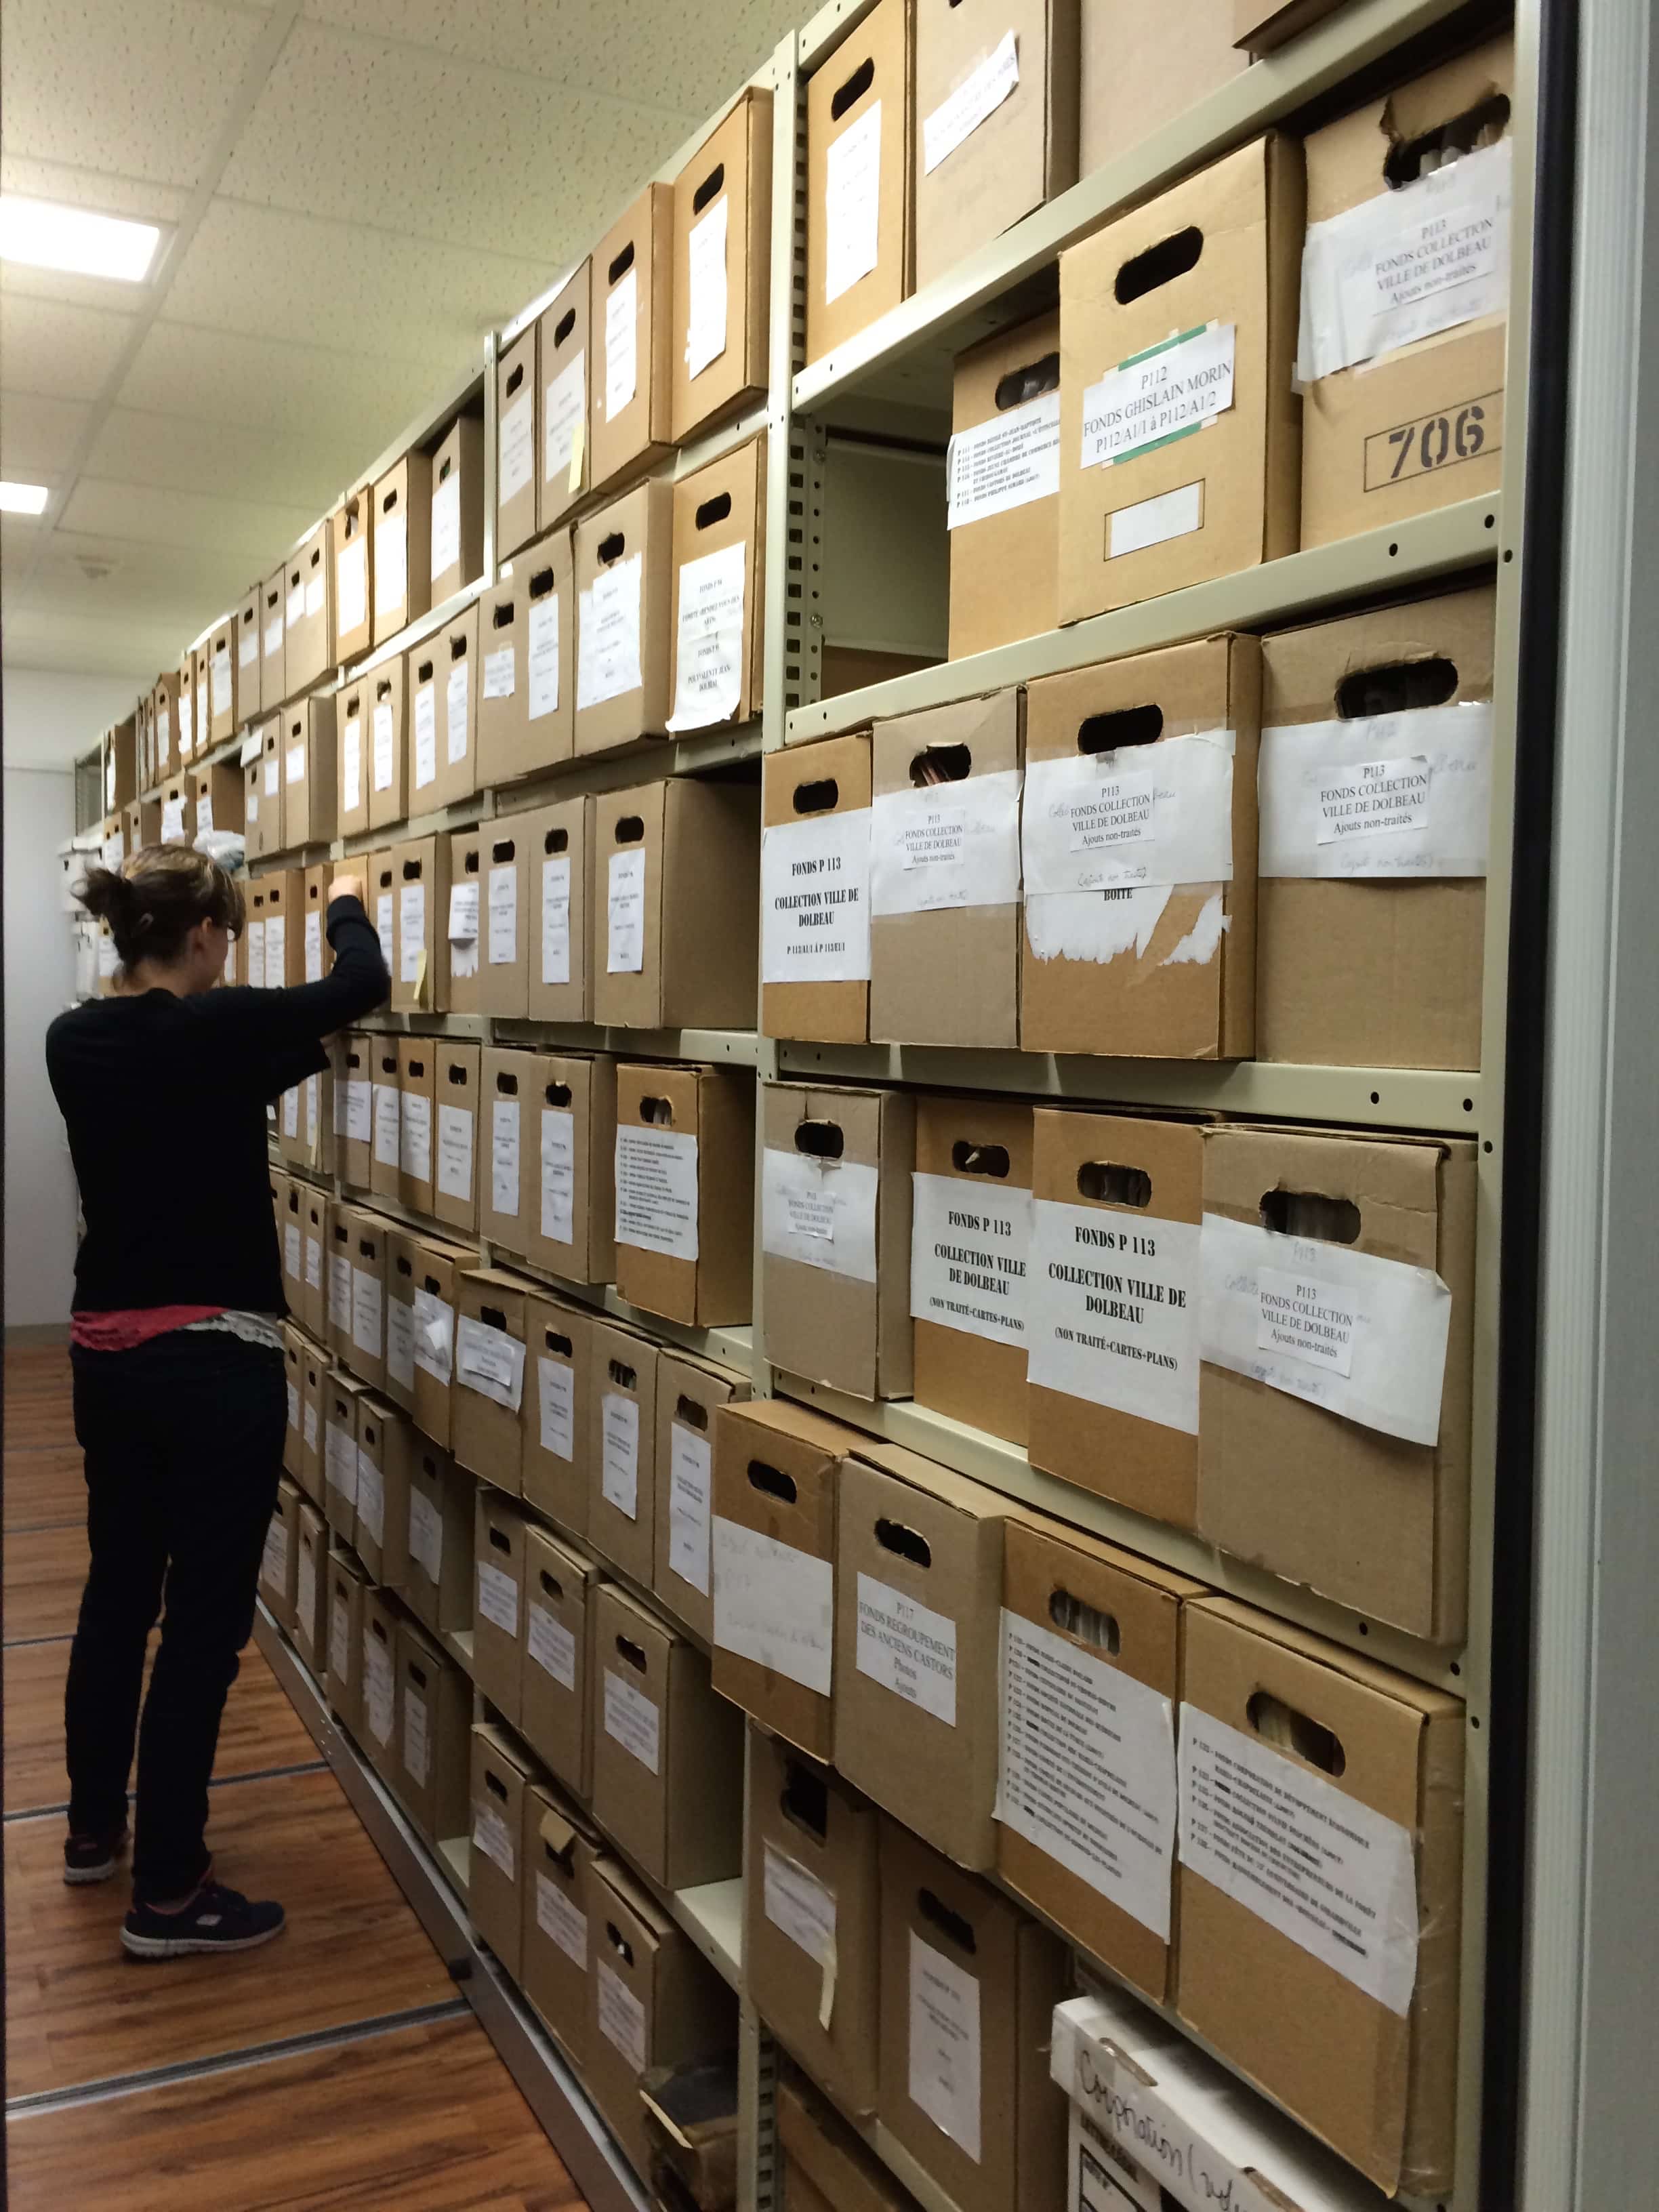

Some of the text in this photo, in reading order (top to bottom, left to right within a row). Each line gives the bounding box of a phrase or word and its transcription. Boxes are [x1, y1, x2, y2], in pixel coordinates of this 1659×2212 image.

[1141, 366, 1168, 390] P112
[1084, 361, 1231, 437] FONDS GHISLAIN MORIN
[1389, 405, 1485, 478] 706
[1363, 764, 1385, 779] P113
[1101, 785, 1120, 798] P113
[1321, 775, 1427, 802] FONDS COLLECTION
[1070, 804, 1097, 819] FONDS
[1099, 794, 1151, 814] COLLECTION
[1323, 792, 1425, 818] VILLE DE DOLBEAU
[927, 814, 941, 825] P113
[1072, 809, 1150, 832] VILLE DE DOLBEAU
[1334, 813, 1412, 835] Ajouts non-traités
[905, 829, 925, 840] FONDS
[926, 825, 963, 838] COLLECTION
[906, 838, 960, 852] VILLE DE DOLBEAU
[1082, 827, 1141, 847] Ajouts non-traités
[792, 857, 841, 876] FONDS P 113
[775, 888, 859, 910] COLLECTION VILLE DE
[798, 911, 835, 927] DOLBEAU
[949, 1211, 1012, 1237] FONDS P 113
[1075, 1226, 1155, 1256] FONDS P 113
[935, 1243, 1026, 1277] COLLECTION VILLE
[949, 1267, 1010, 1295] DE DOLBEAU
[1048, 1263, 1187, 1309] COLLECTION VILLE DE
[1296, 1284, 1317, 1300] P113
[1085, 1294, 1144, 1324] DOLBEAU
[1261, 1292, 1353, 1327] FONDS COLLECTION
[1054, 1326, 1074, 1341] (NON
[1262, 1309, 1350, 1344] VILLE DE DOLBEAU
[1271, 1328, 1338, 1358] Ajouts non-traités
[859, 1601, 955, 1661] FONDS REGROUPEMENT
[861, 1620, 954, 1681] DES ANCIENS CASTORS
